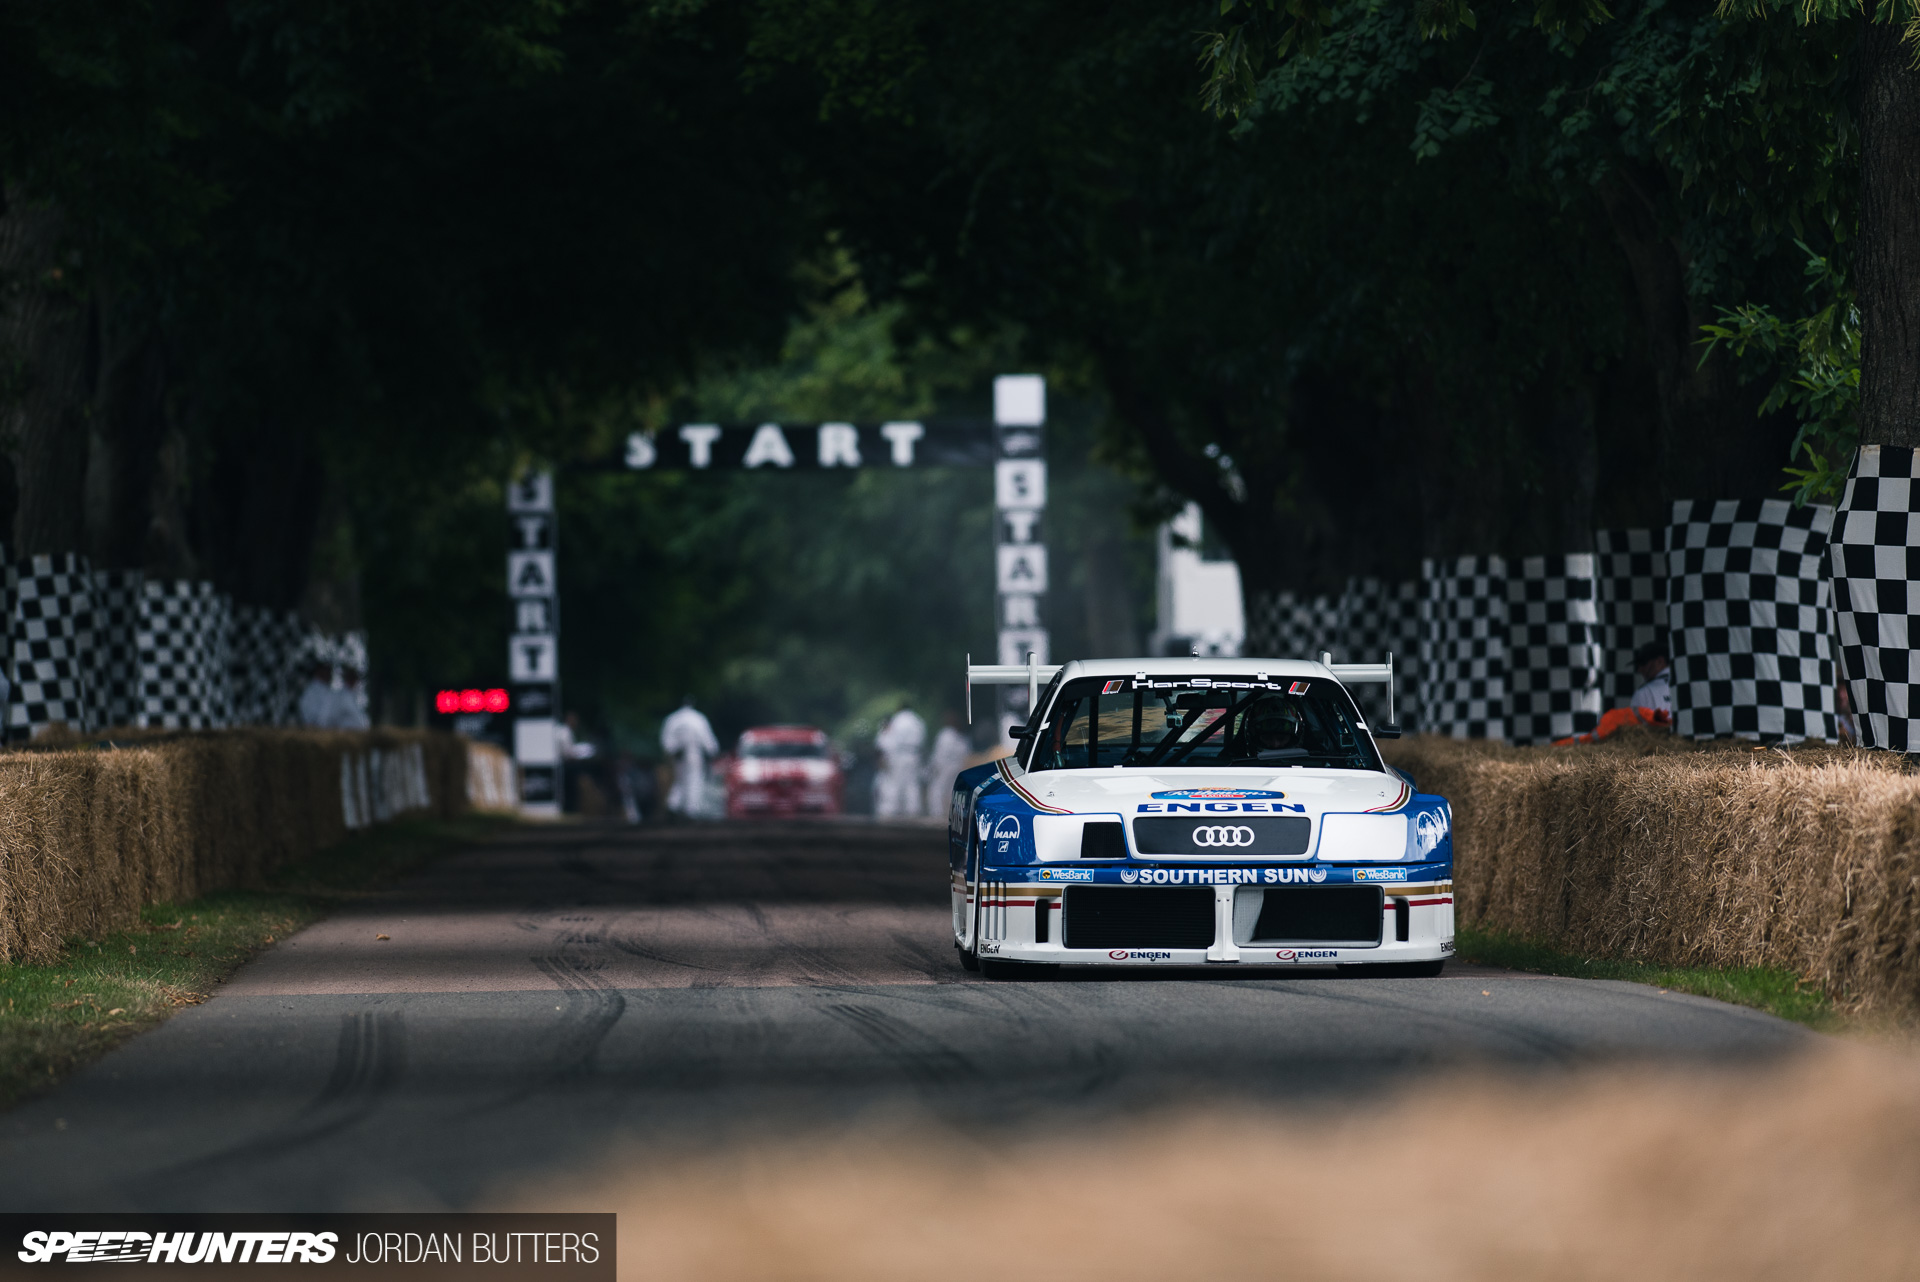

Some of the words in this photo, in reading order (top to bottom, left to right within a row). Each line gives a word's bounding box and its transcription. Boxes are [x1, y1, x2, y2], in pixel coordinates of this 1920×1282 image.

[624, 421, 923, 468] START
[1131, 678, 1282, 690] HanSport
[1137, 803, 1305, 812] ENGEN
[995, 831, 1017, 839] MAN
[1052, 869, 1091, 881] WesBank
[1139, 869, 1258, 885] SOUTHERN
[1264, 868, 1309, 884] SUN
[1366, 869, 1405, 881] WesBank
[1130, 951, 1171, 959] ENGEN
[1297, 950, 1338, 958] ENGEN
